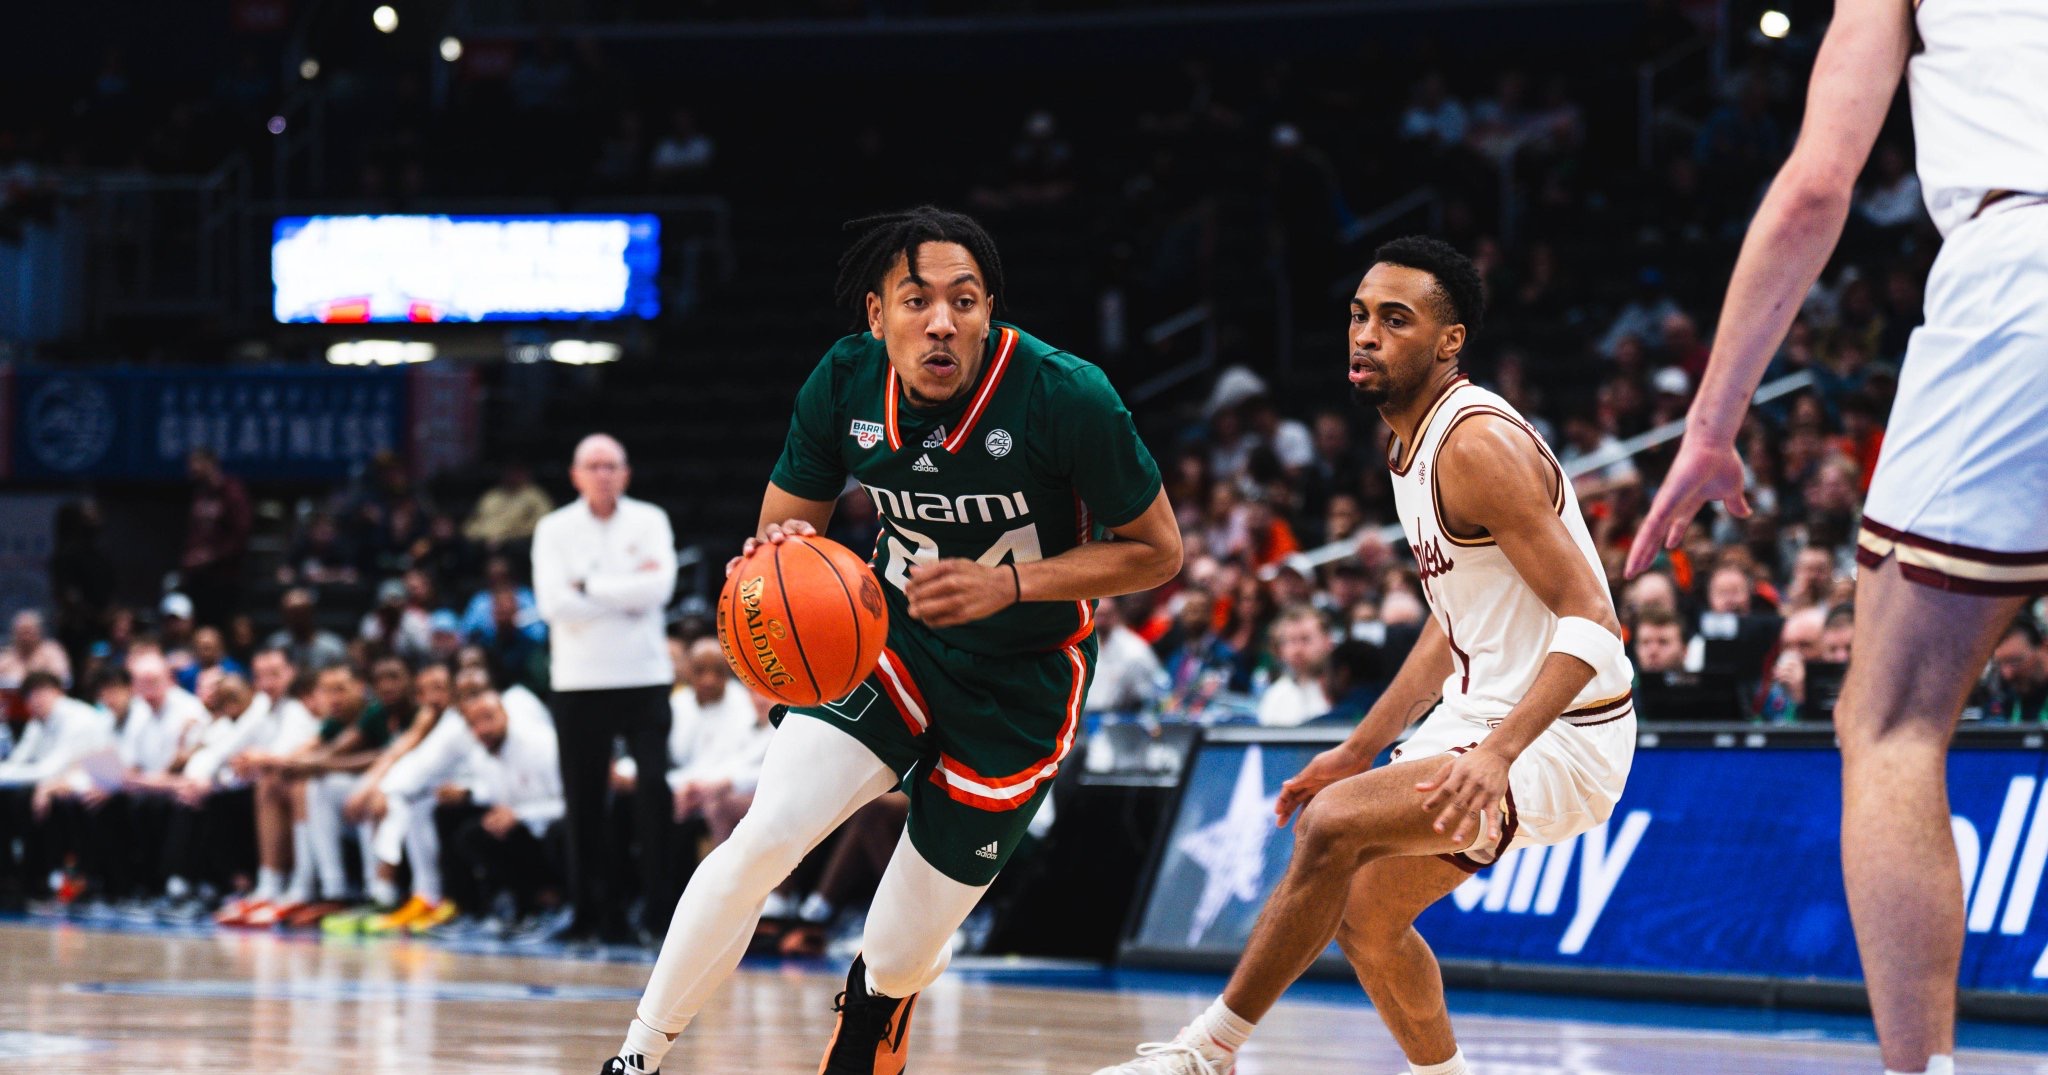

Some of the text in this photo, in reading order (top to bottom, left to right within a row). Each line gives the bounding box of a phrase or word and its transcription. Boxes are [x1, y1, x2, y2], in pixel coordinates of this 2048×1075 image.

[860, 432, 876, 443] 24
[988, 438, 1010, 446] ACC
[911, 464, 939, 473] adidas
[741, 576, 795, 687] SPALDING
[975, 849, 998, 860] adidas
